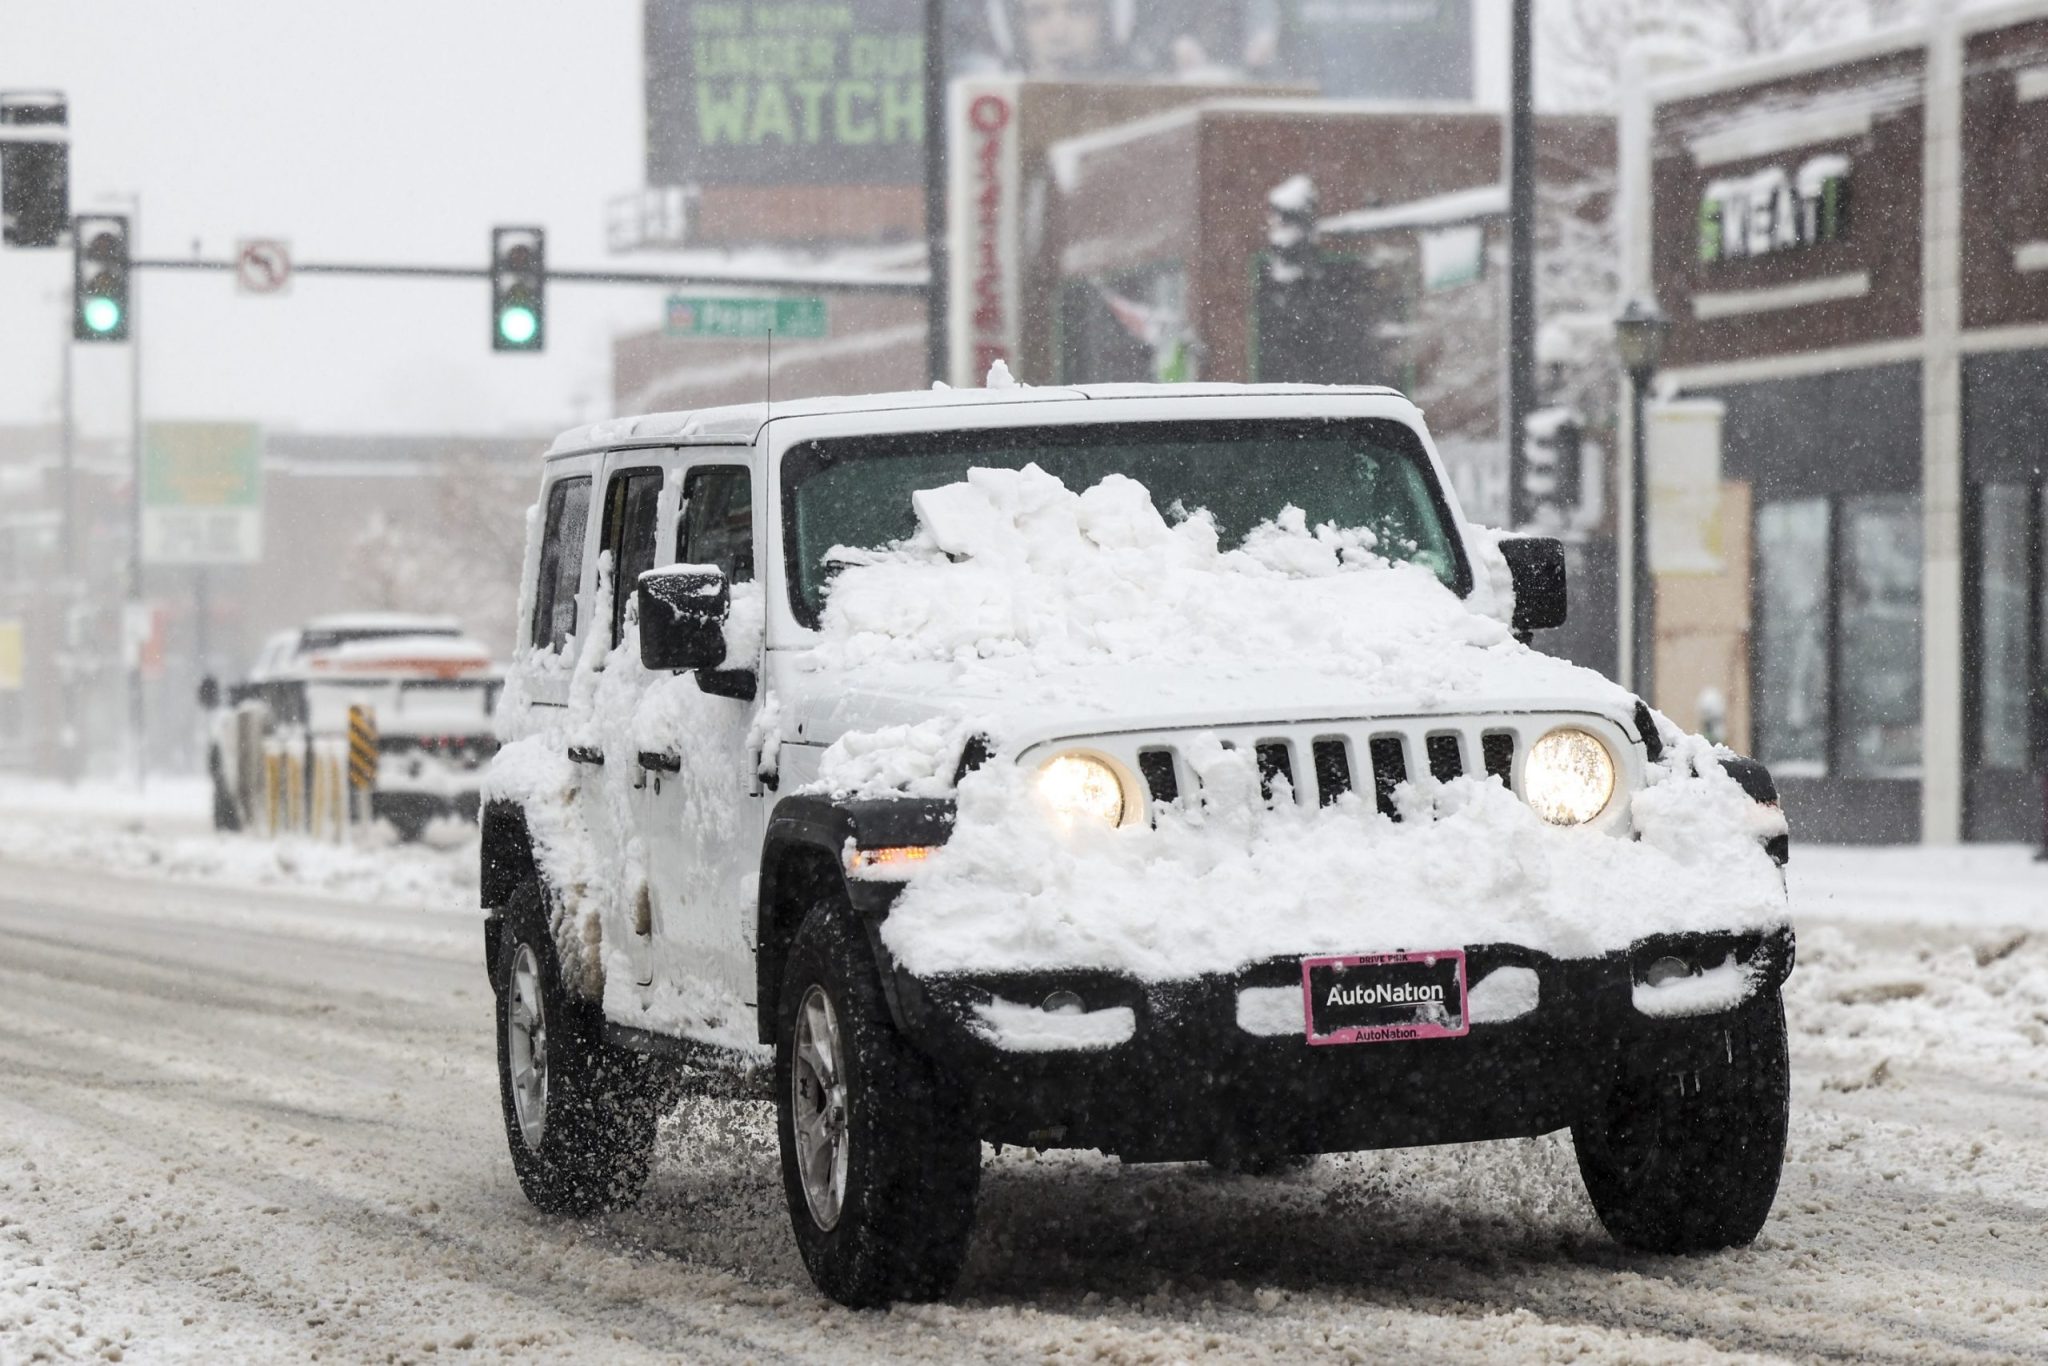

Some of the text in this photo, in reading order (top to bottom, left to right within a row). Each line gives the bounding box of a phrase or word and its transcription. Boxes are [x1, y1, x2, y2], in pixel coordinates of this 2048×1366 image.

[698, 81, 925, 144] WATCH
[1359, 954, 1385, 964] DRIVE
[1326, 982, 1444, 1006] AutoNation
[1355, 1028, 1417, 1041] AutoNation
